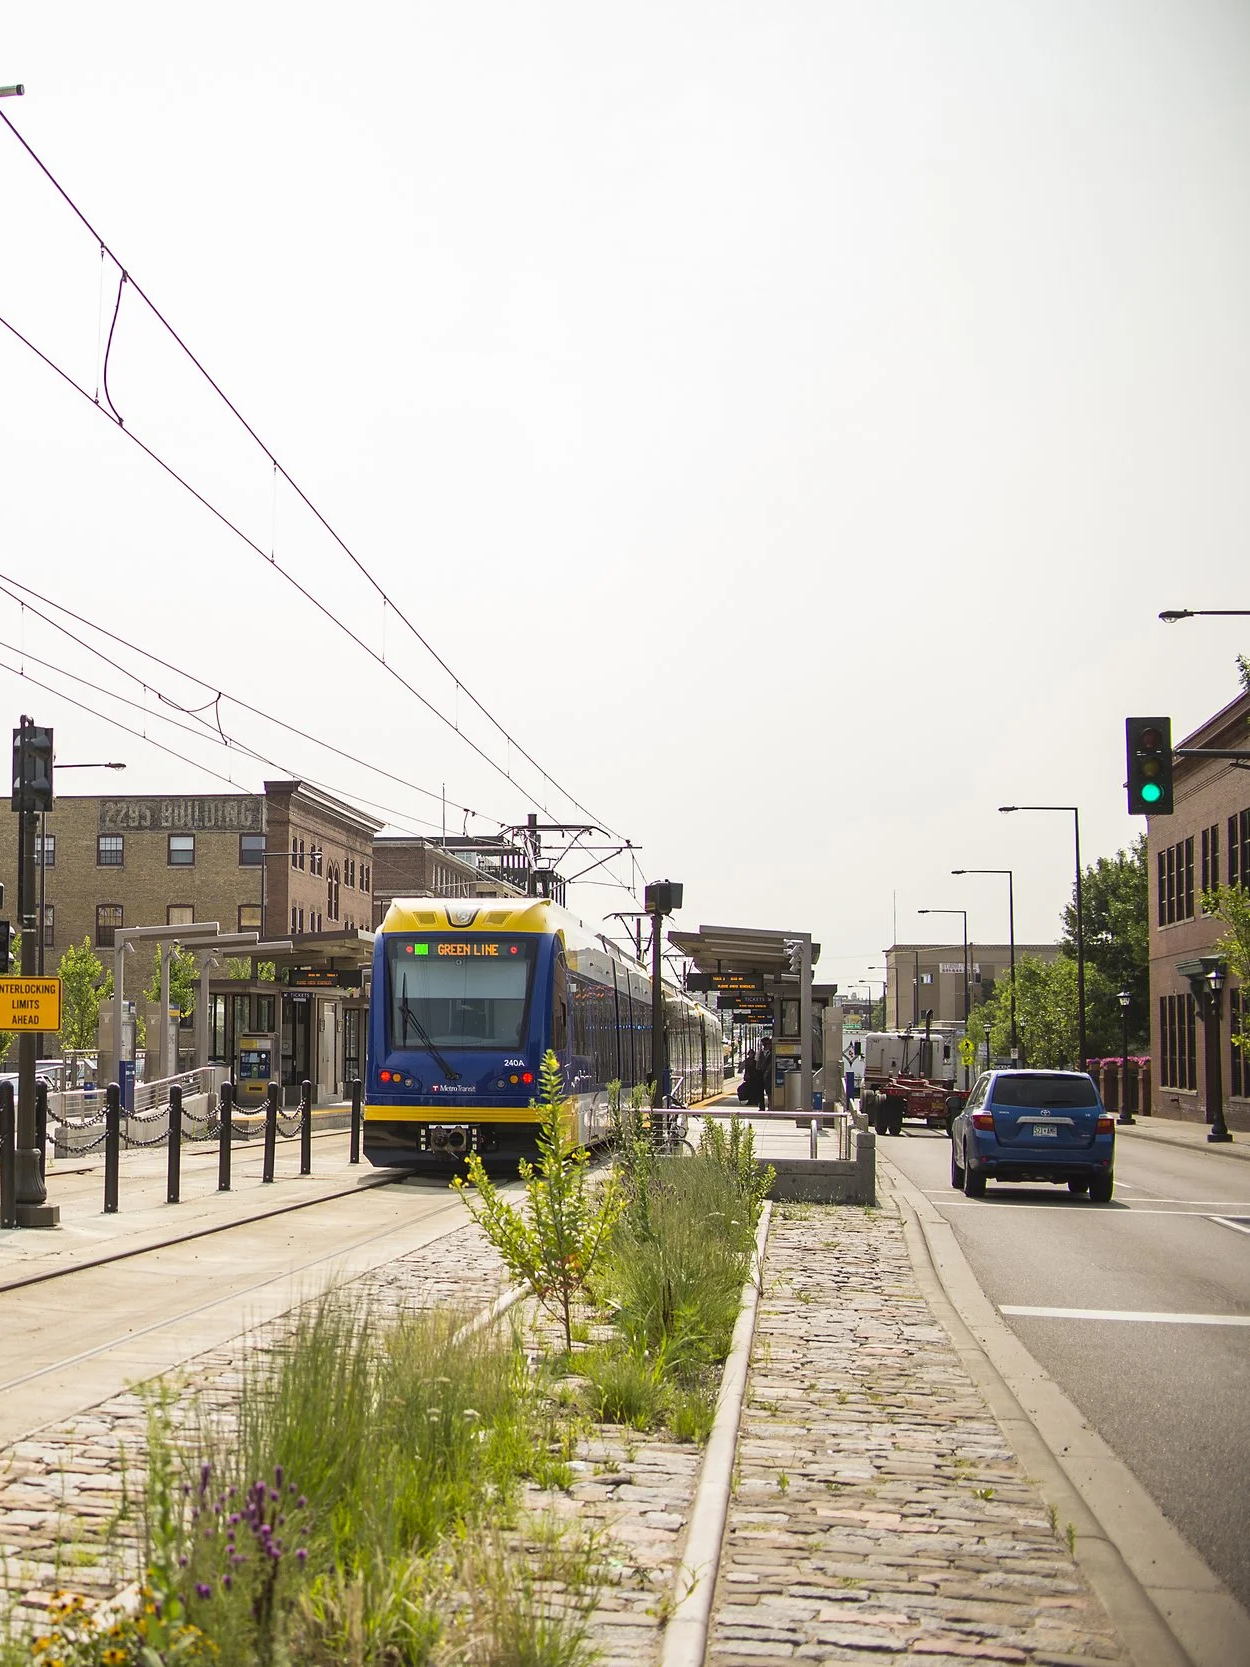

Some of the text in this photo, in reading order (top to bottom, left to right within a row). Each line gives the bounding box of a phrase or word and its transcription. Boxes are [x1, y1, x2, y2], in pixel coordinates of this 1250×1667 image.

[160, 799, 252, 828] BUILDING
[437, 944, 499, 956] GREEN LINE
[11, 999, 40, 1010] LIMITS
[11, 1015, 40, 1025] AHEAD
[504, 1059, 526, 1067] 240A
